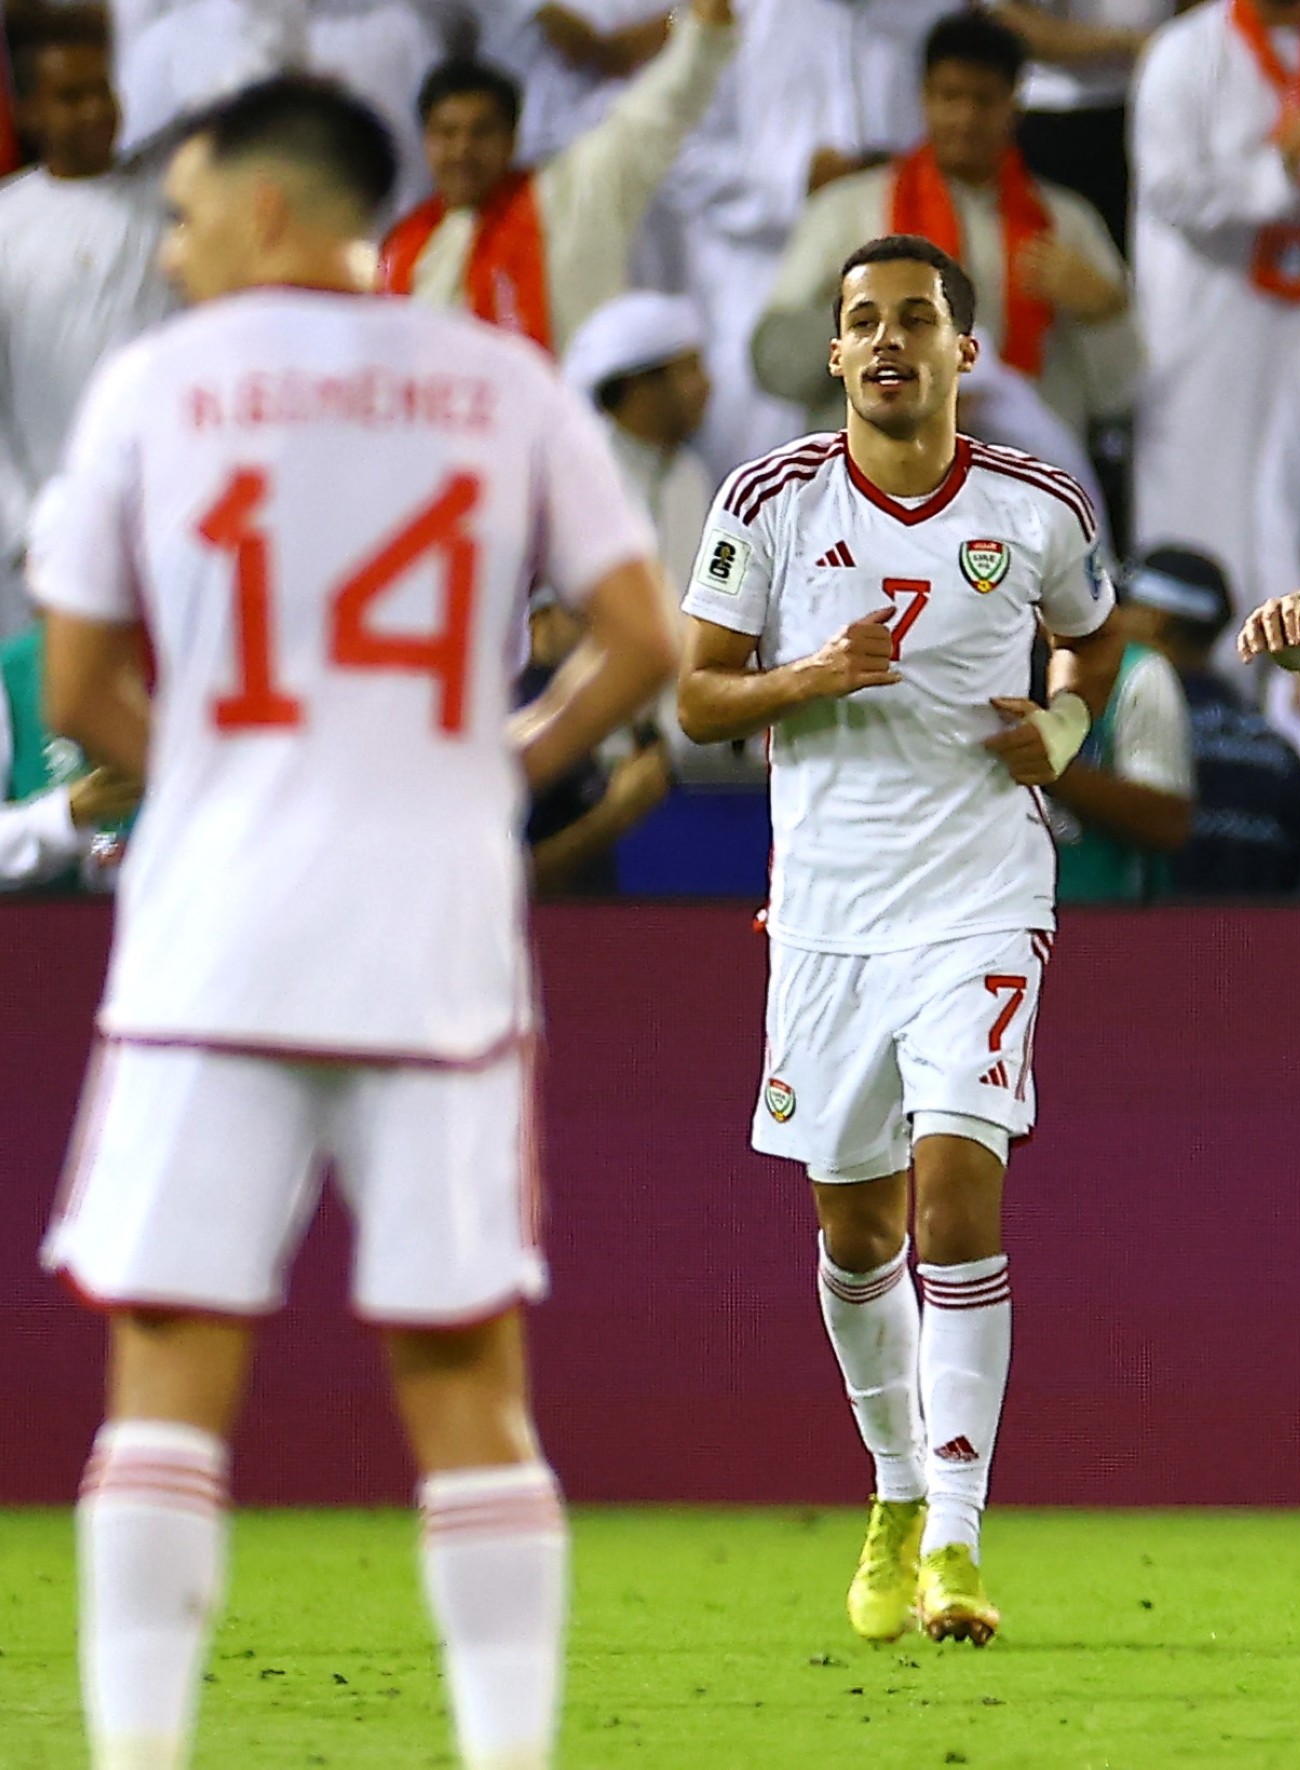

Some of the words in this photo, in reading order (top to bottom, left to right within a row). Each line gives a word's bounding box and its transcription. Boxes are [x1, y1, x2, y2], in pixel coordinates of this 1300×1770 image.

[195, 466, 484, 736] 14
[882, 577, 931, 661] 7
[985, 975, 1027, 1052] 7
